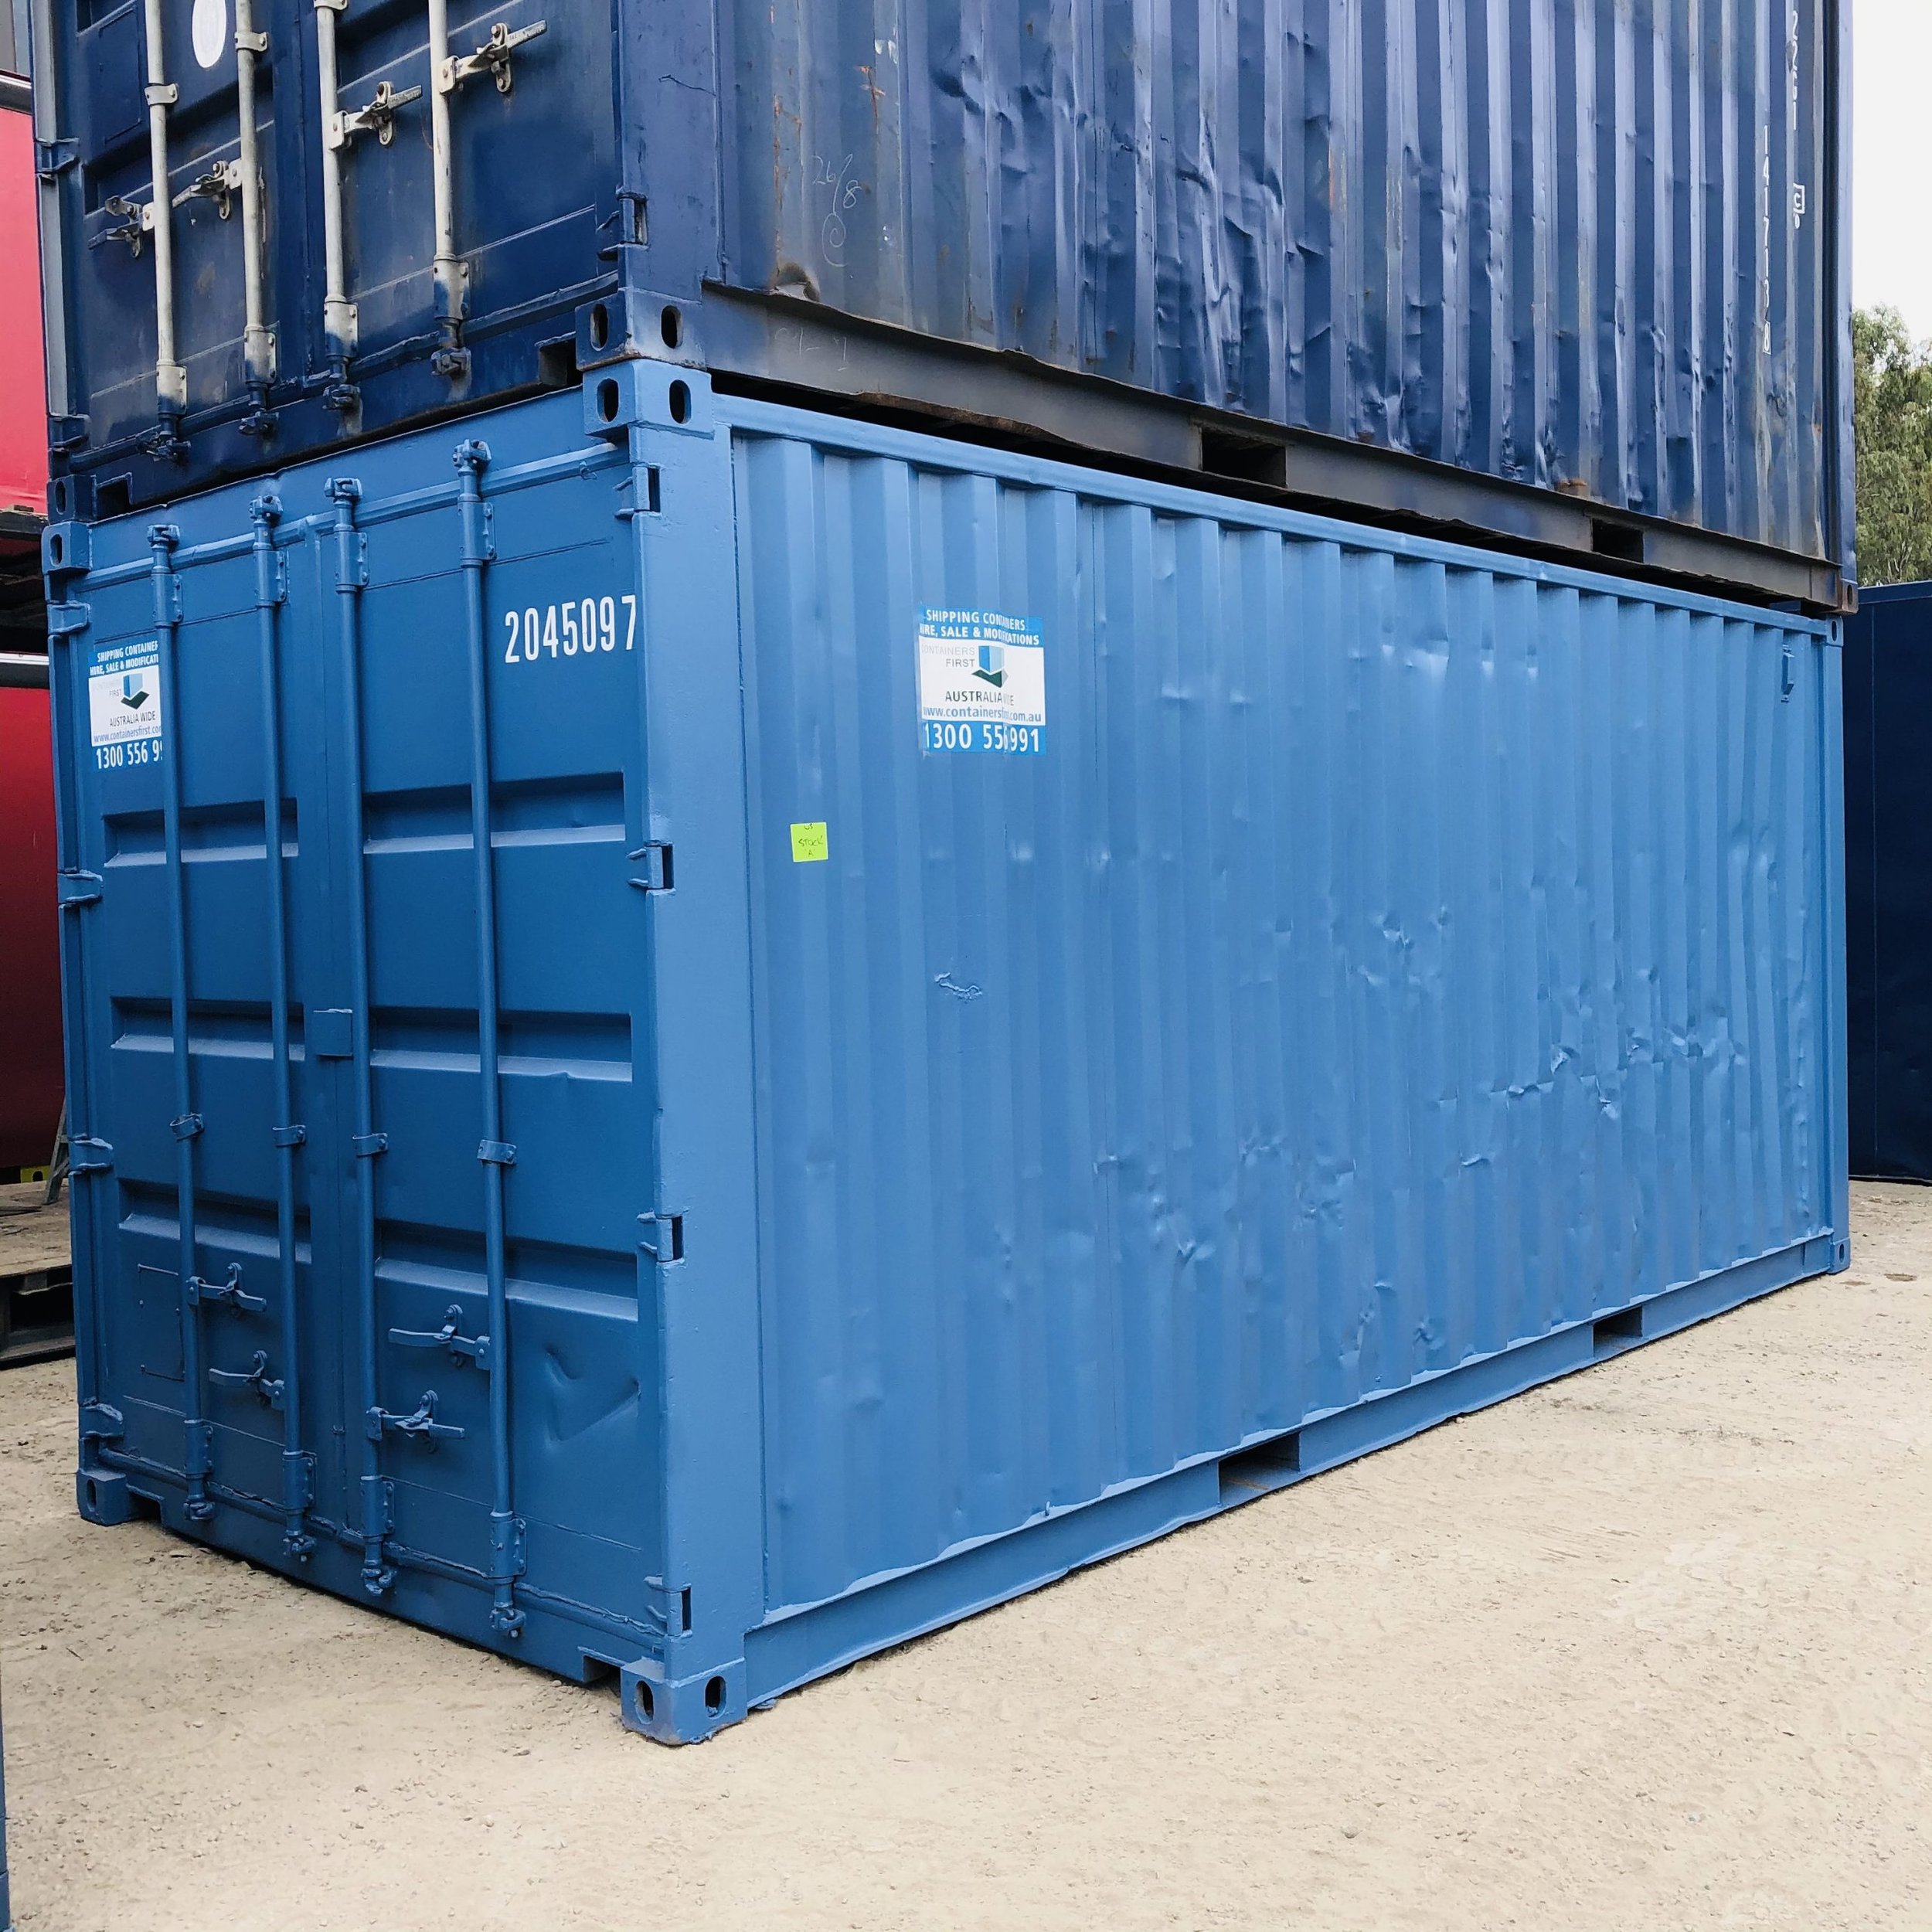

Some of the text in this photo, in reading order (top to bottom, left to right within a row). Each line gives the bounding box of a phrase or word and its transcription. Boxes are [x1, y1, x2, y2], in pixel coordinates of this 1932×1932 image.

[926, 609, 1026, 631] SHIPPING CONERS
[920, 623, 1039, 645] IRE, SALE & MODATIONS
[97, 648, 124, 662] SHIPPING
[945, 658, 975, 668] FIRST
[89, 665, 105, 676] HIRE,
[105, 662, 119, 673] SALE
[120, 661, 124, 670] &
[945, 691, 1002, 703] AUSTRALIA
[109, 711, 156, 727] AUSTRALIA WIDE
[924, 723, 972, 750] 1300
[96, 745, 124, 770] 1300
[127, 741, 148, 765] 556
